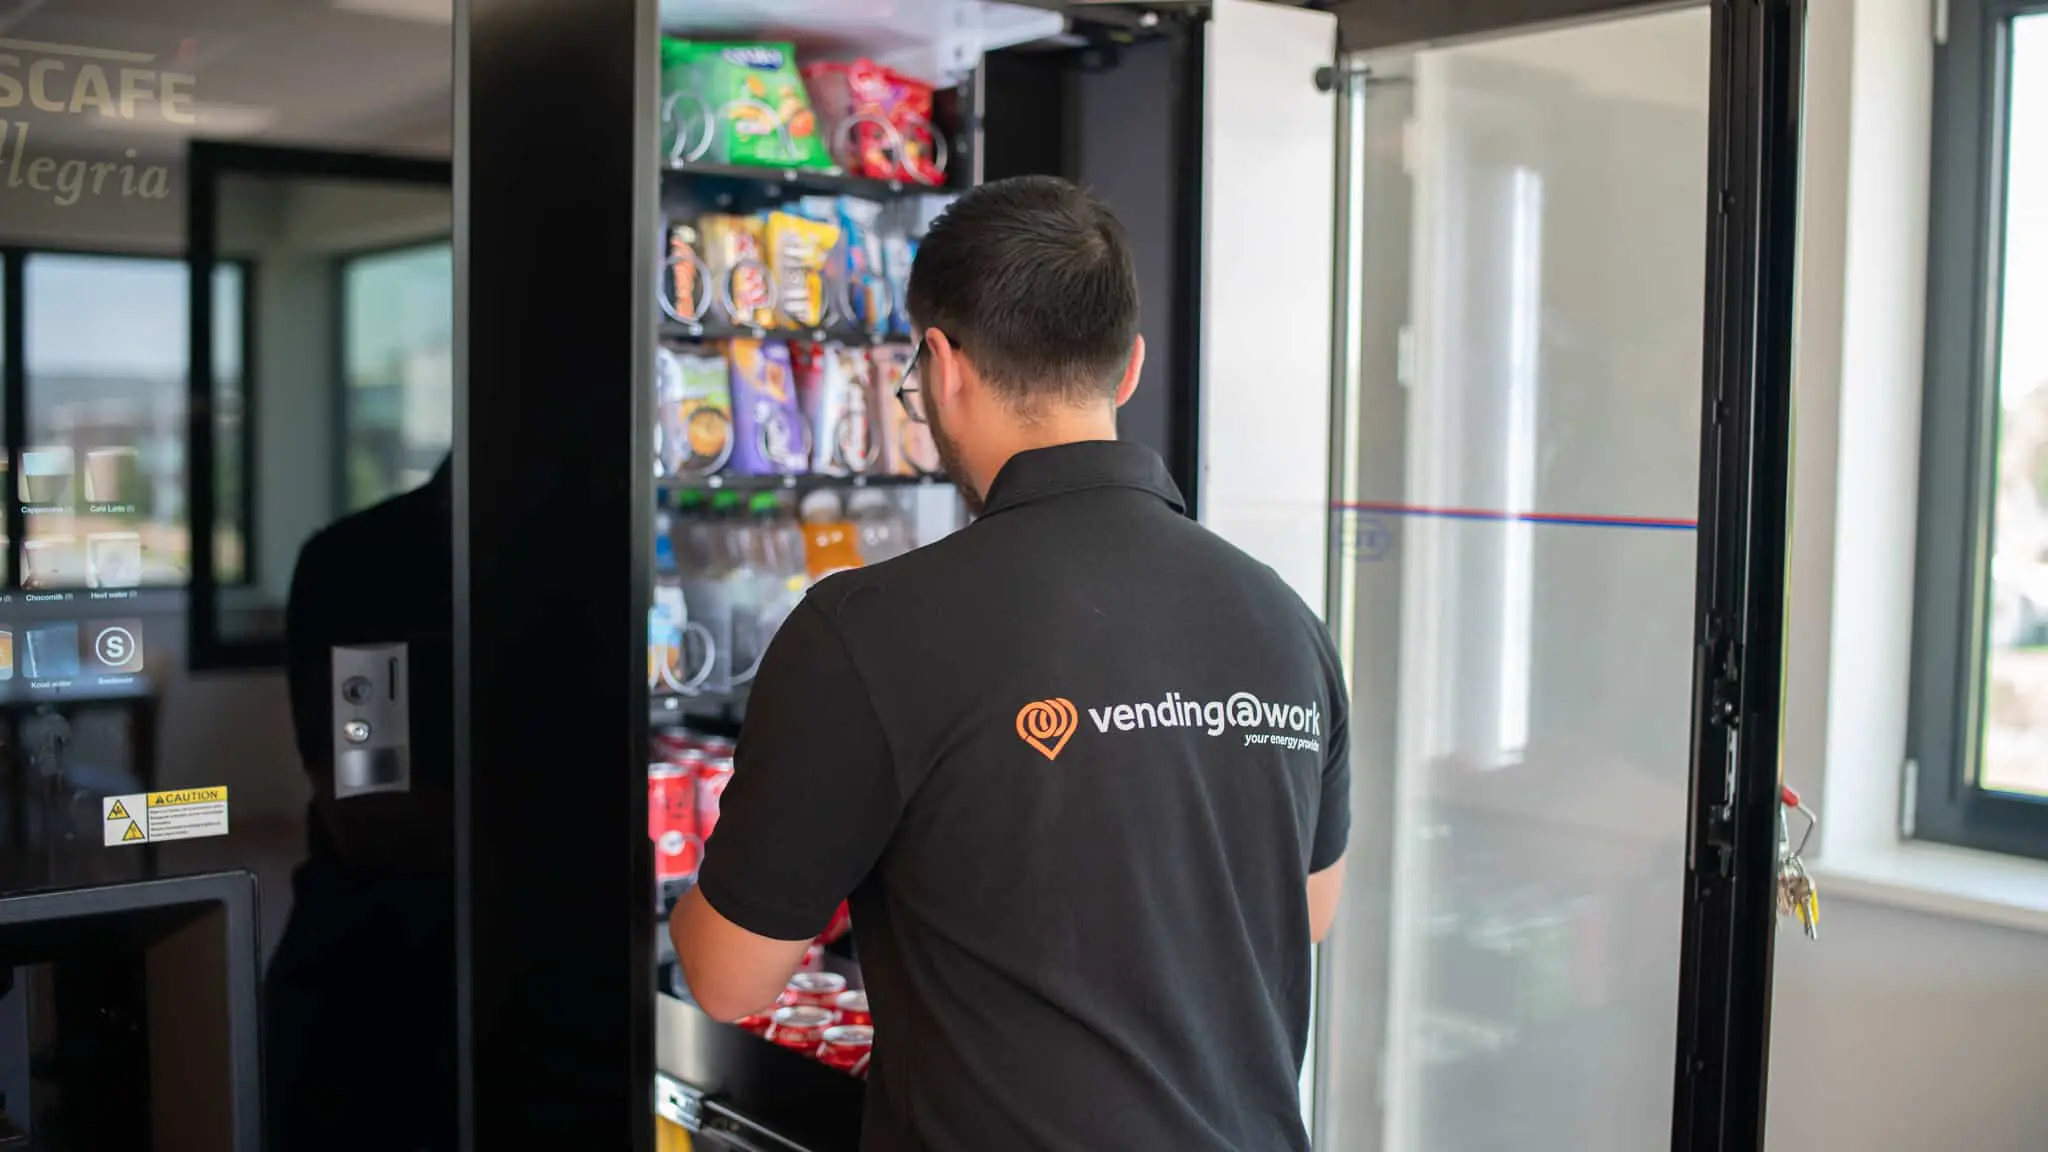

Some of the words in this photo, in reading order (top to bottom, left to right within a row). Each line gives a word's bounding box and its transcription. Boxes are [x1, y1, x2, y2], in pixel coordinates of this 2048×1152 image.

[1088, 692, 1320, 737] vending@work
[1244, 733, 1269, 746] your
[1270, 735, 1298, 750] energy
[165, 791, 218, 804] CAUTION
